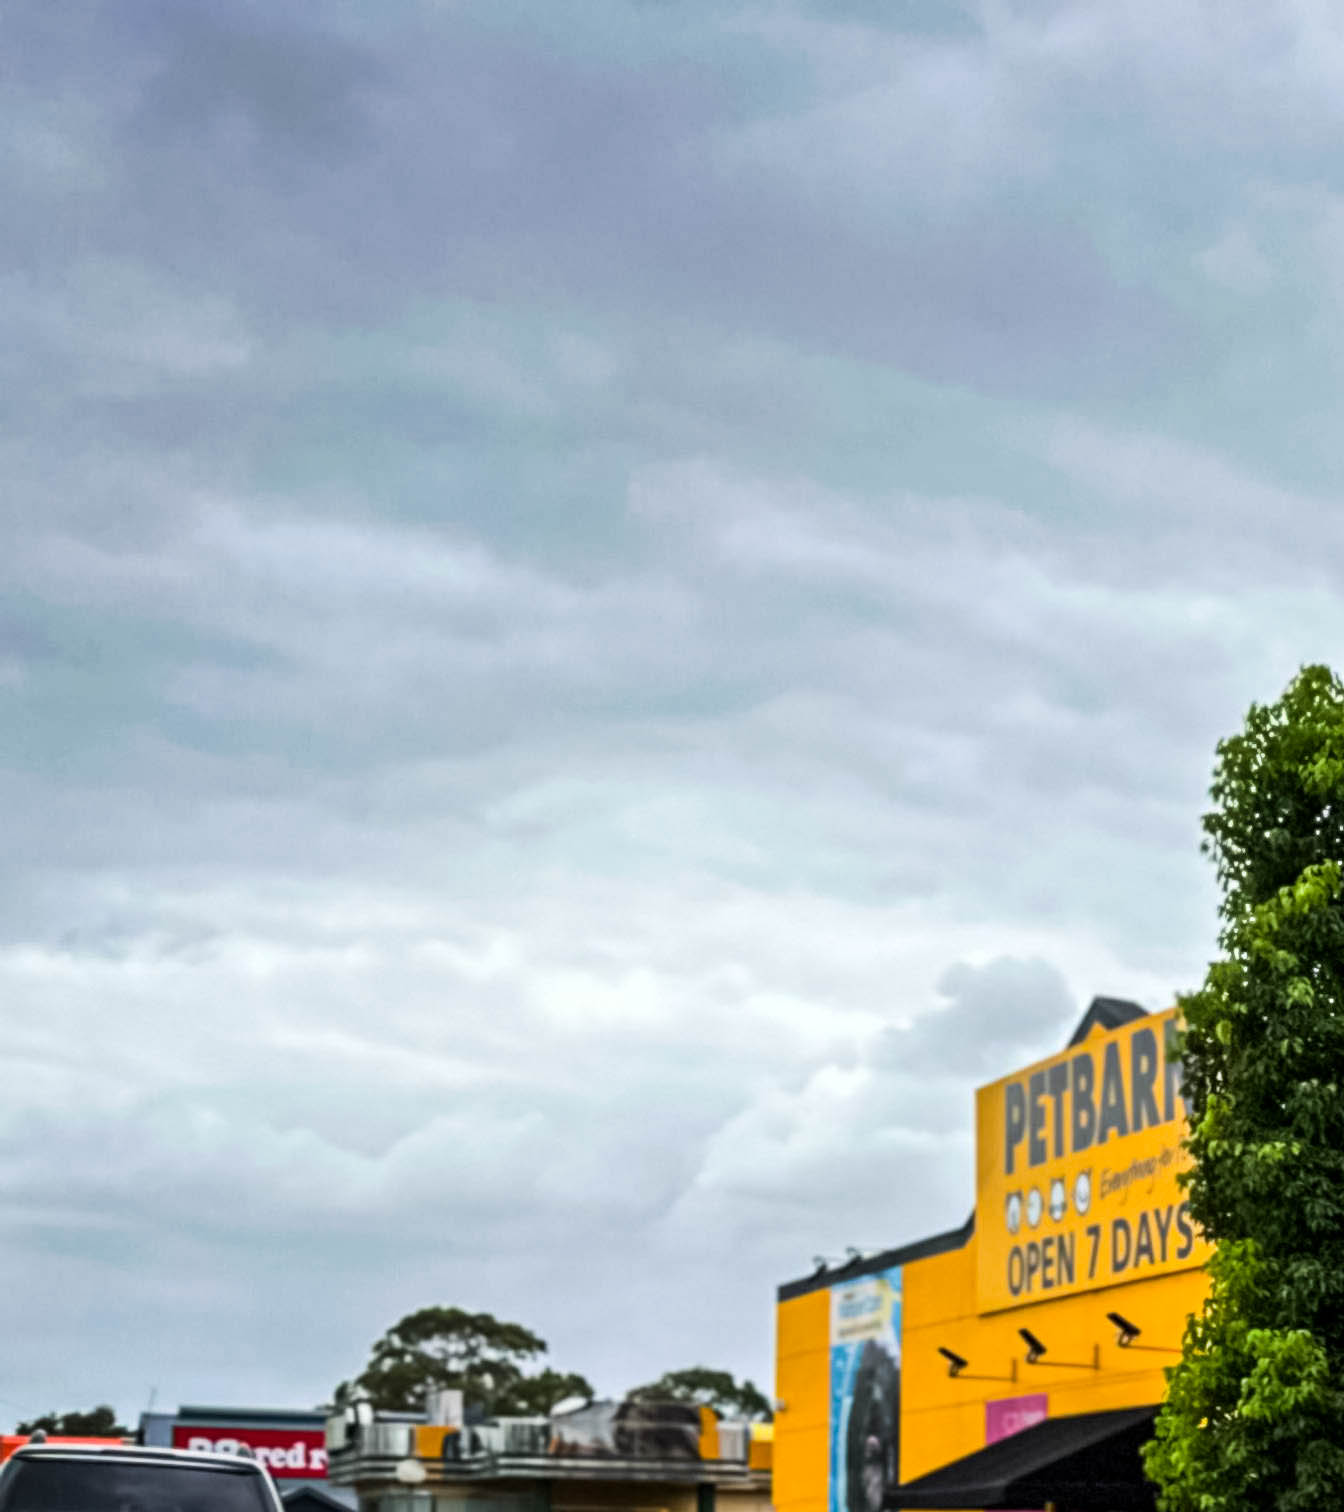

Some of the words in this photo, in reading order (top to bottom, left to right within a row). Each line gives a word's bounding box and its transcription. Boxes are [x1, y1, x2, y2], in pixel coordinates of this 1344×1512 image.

[1008, 1231, 1075, 1296] OPEN
[1086, 1223, 1101, 1280] 7
[1112, 1201, 1193, 1274] DAYS
